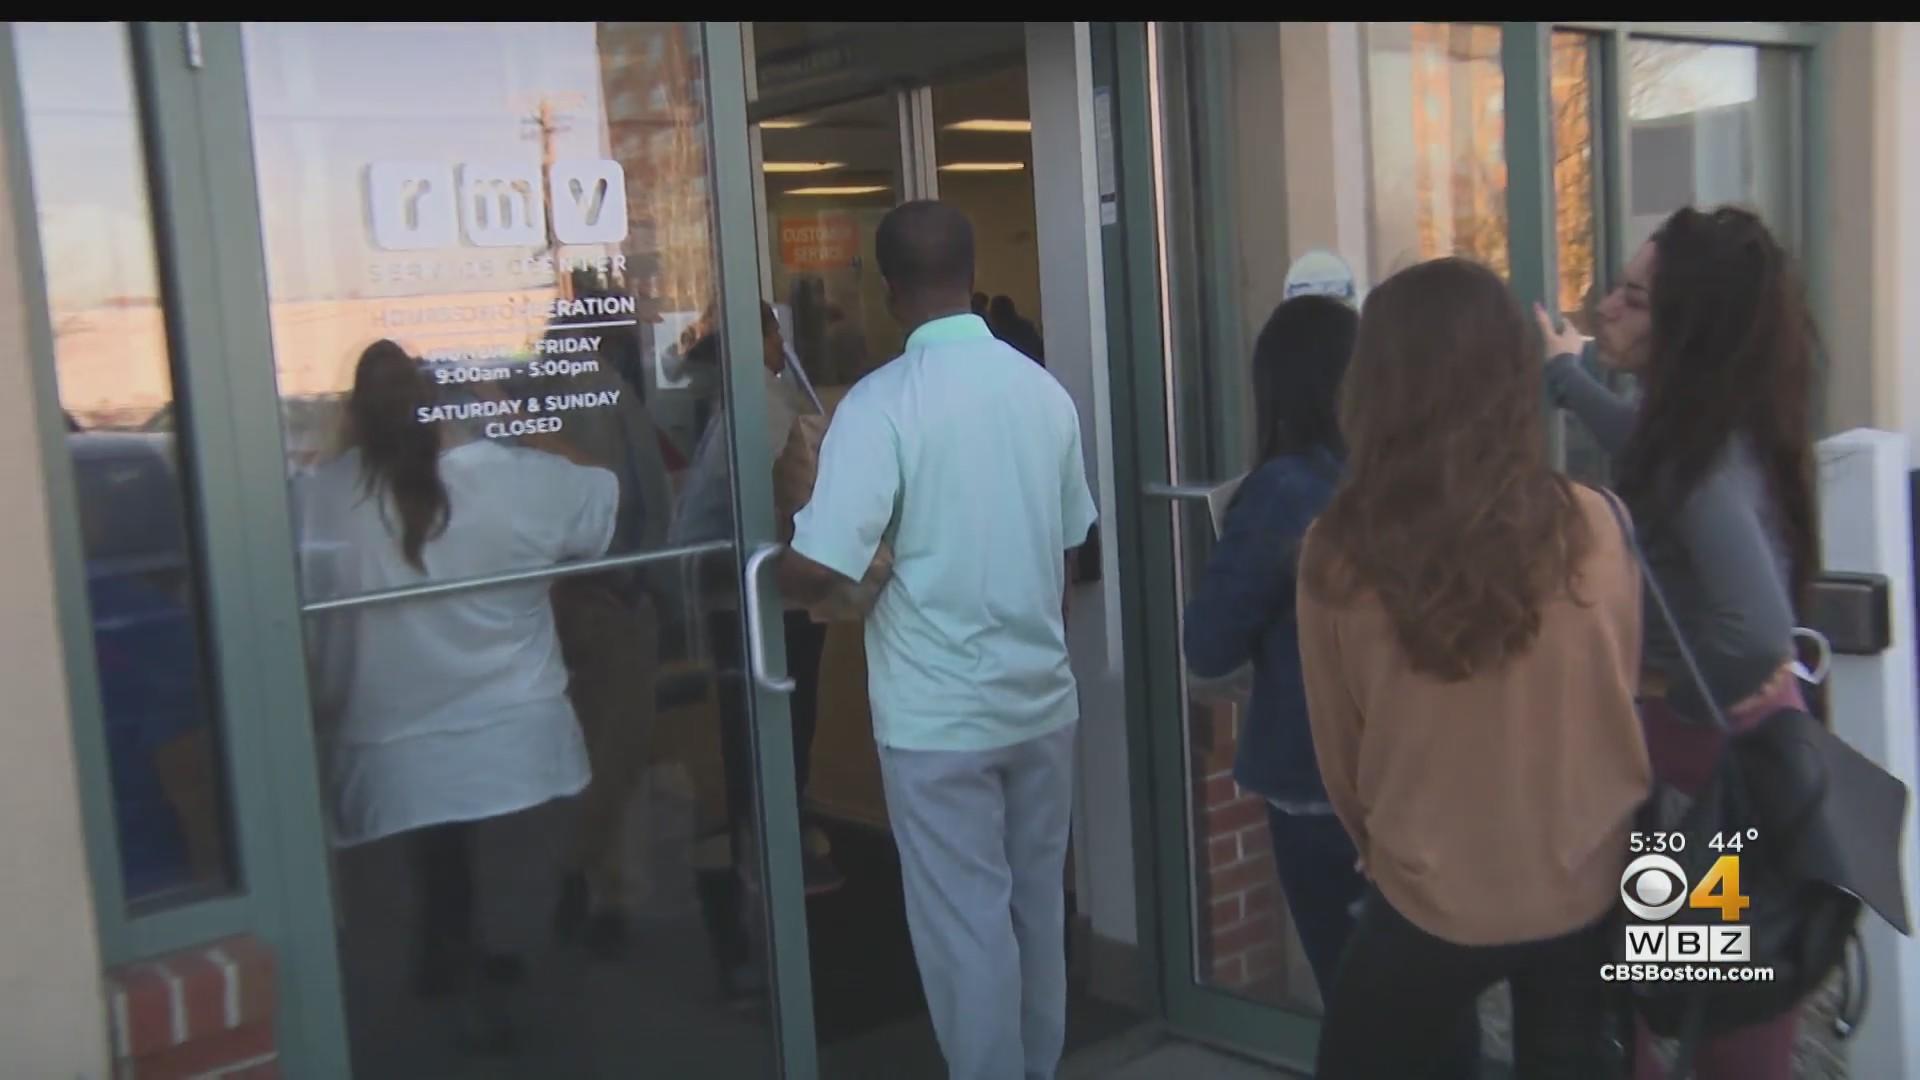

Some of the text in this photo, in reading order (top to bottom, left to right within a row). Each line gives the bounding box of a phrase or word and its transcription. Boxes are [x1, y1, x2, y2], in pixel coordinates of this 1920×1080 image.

[534, 336, 602, 356] FRIDAY
[435, 365, 511, 385] 9:00am
[528, 358, 600, 378] 5:00pm
[416, 391, 621, 424] SATURDAY & SUNDAY
[485, 417, 563, 439] CLOSED
